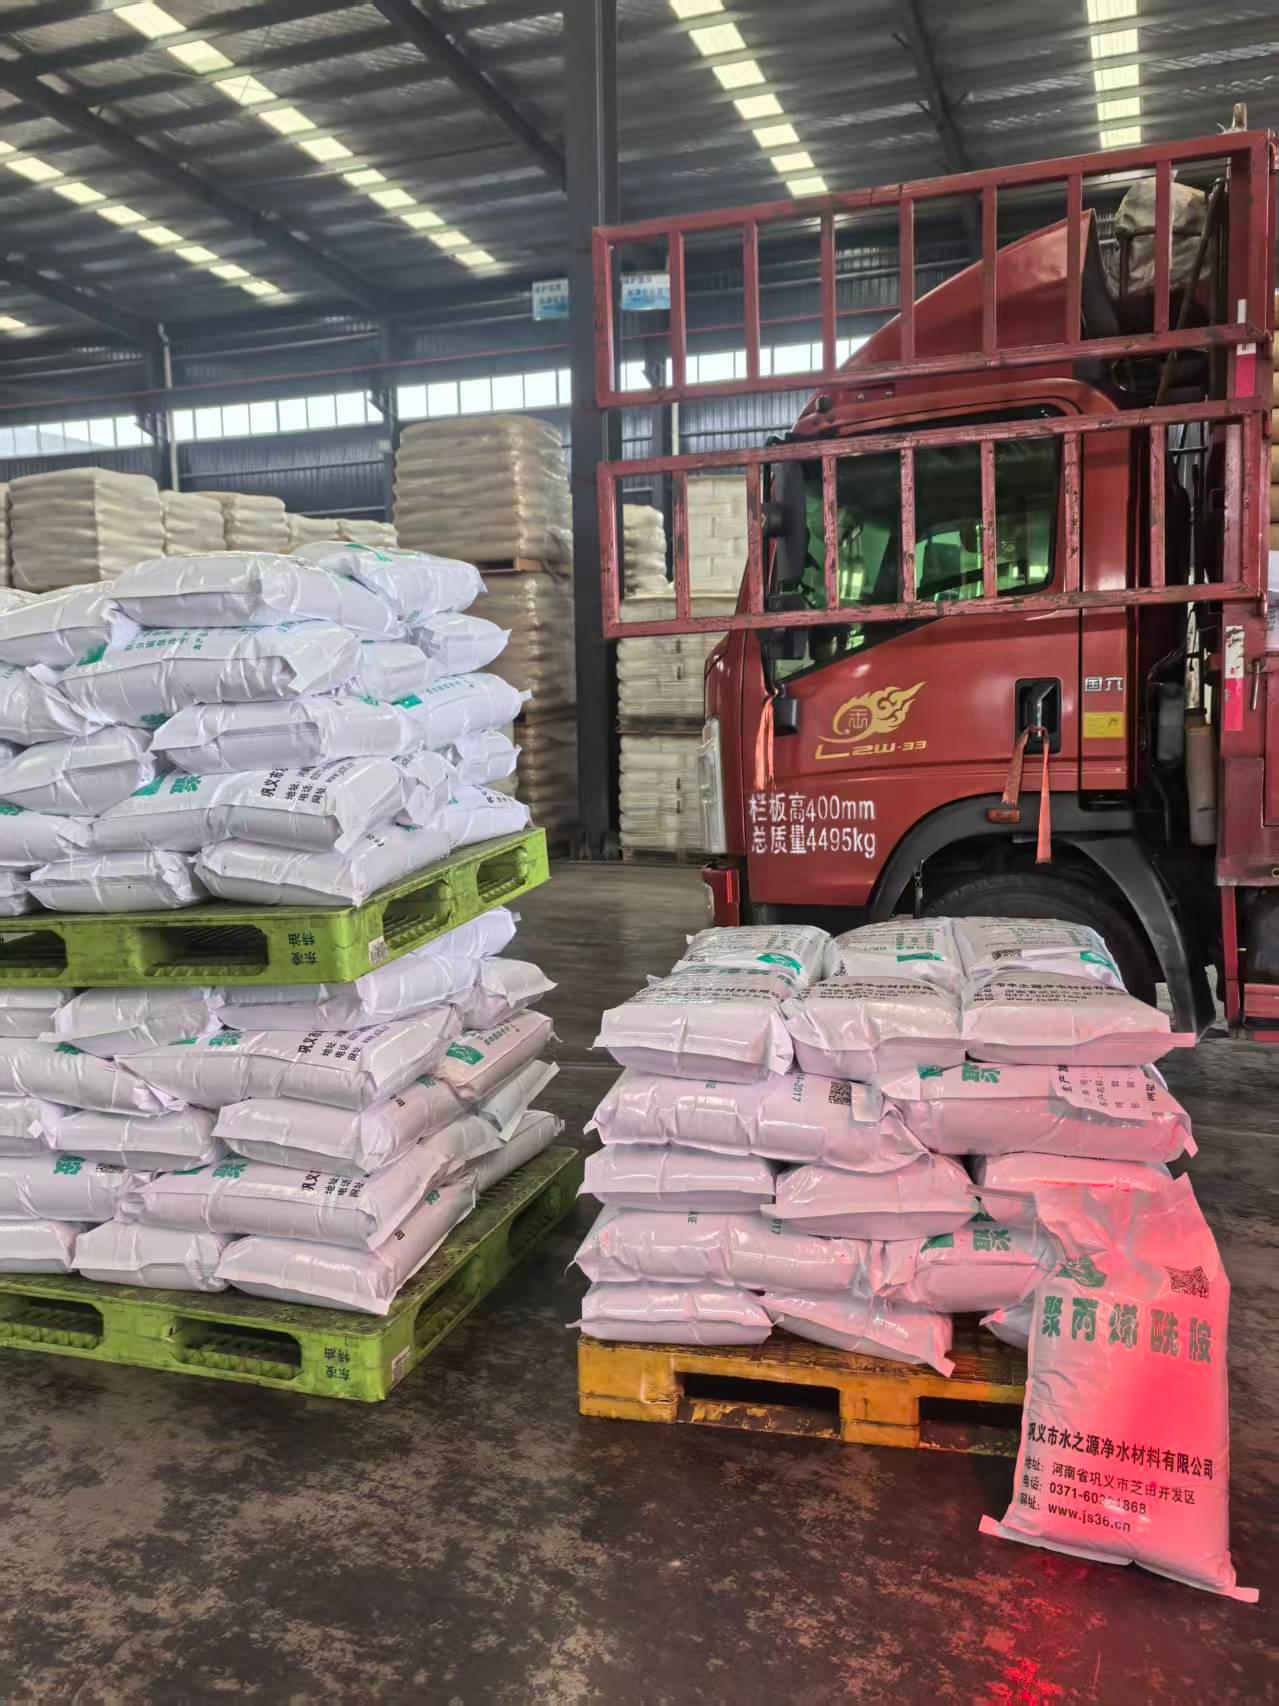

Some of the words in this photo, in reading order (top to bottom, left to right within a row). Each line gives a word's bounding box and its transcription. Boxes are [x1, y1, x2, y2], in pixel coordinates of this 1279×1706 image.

[1085, 677, 1124, 692] 国六
[749, 792, 877, 823] 栏板高400mm
[751, 824, 877, 859] 总质量4495kg
[1028, 1422, 1214, 1480] 巩义市水之源净水材料有限公司
[1052, 1462, 1196, 1505] 河南省巩义市芝田开发区
[1048, 1503, 1131, 1532] www.js36.cn
